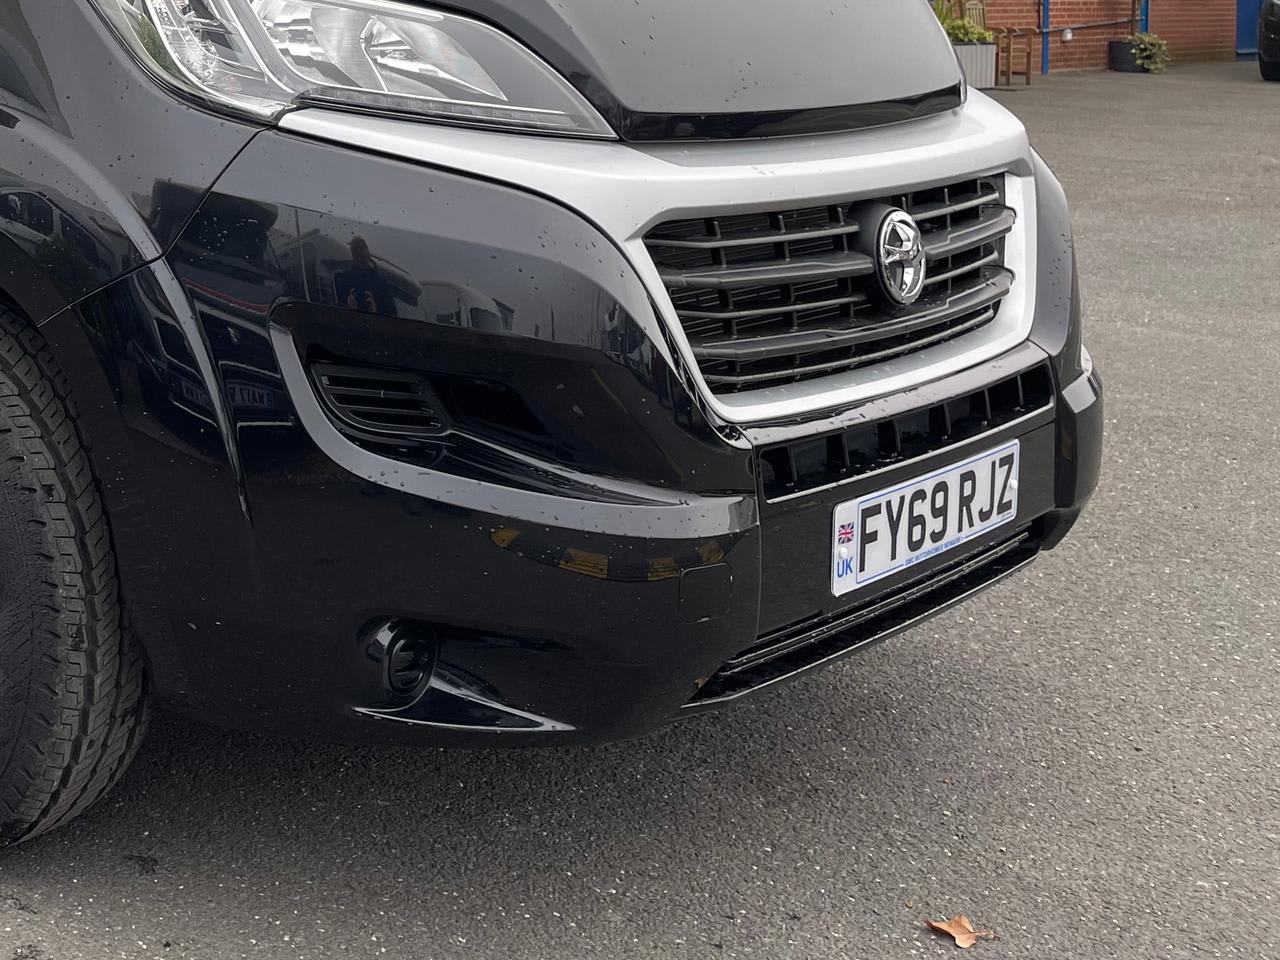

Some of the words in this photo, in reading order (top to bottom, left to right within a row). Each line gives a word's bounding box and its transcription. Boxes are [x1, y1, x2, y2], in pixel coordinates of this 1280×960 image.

[859, 481, 949, 573] FY69
[958, 452, 1015, 533] RJZ
[837, 557, 853, 578] UK
